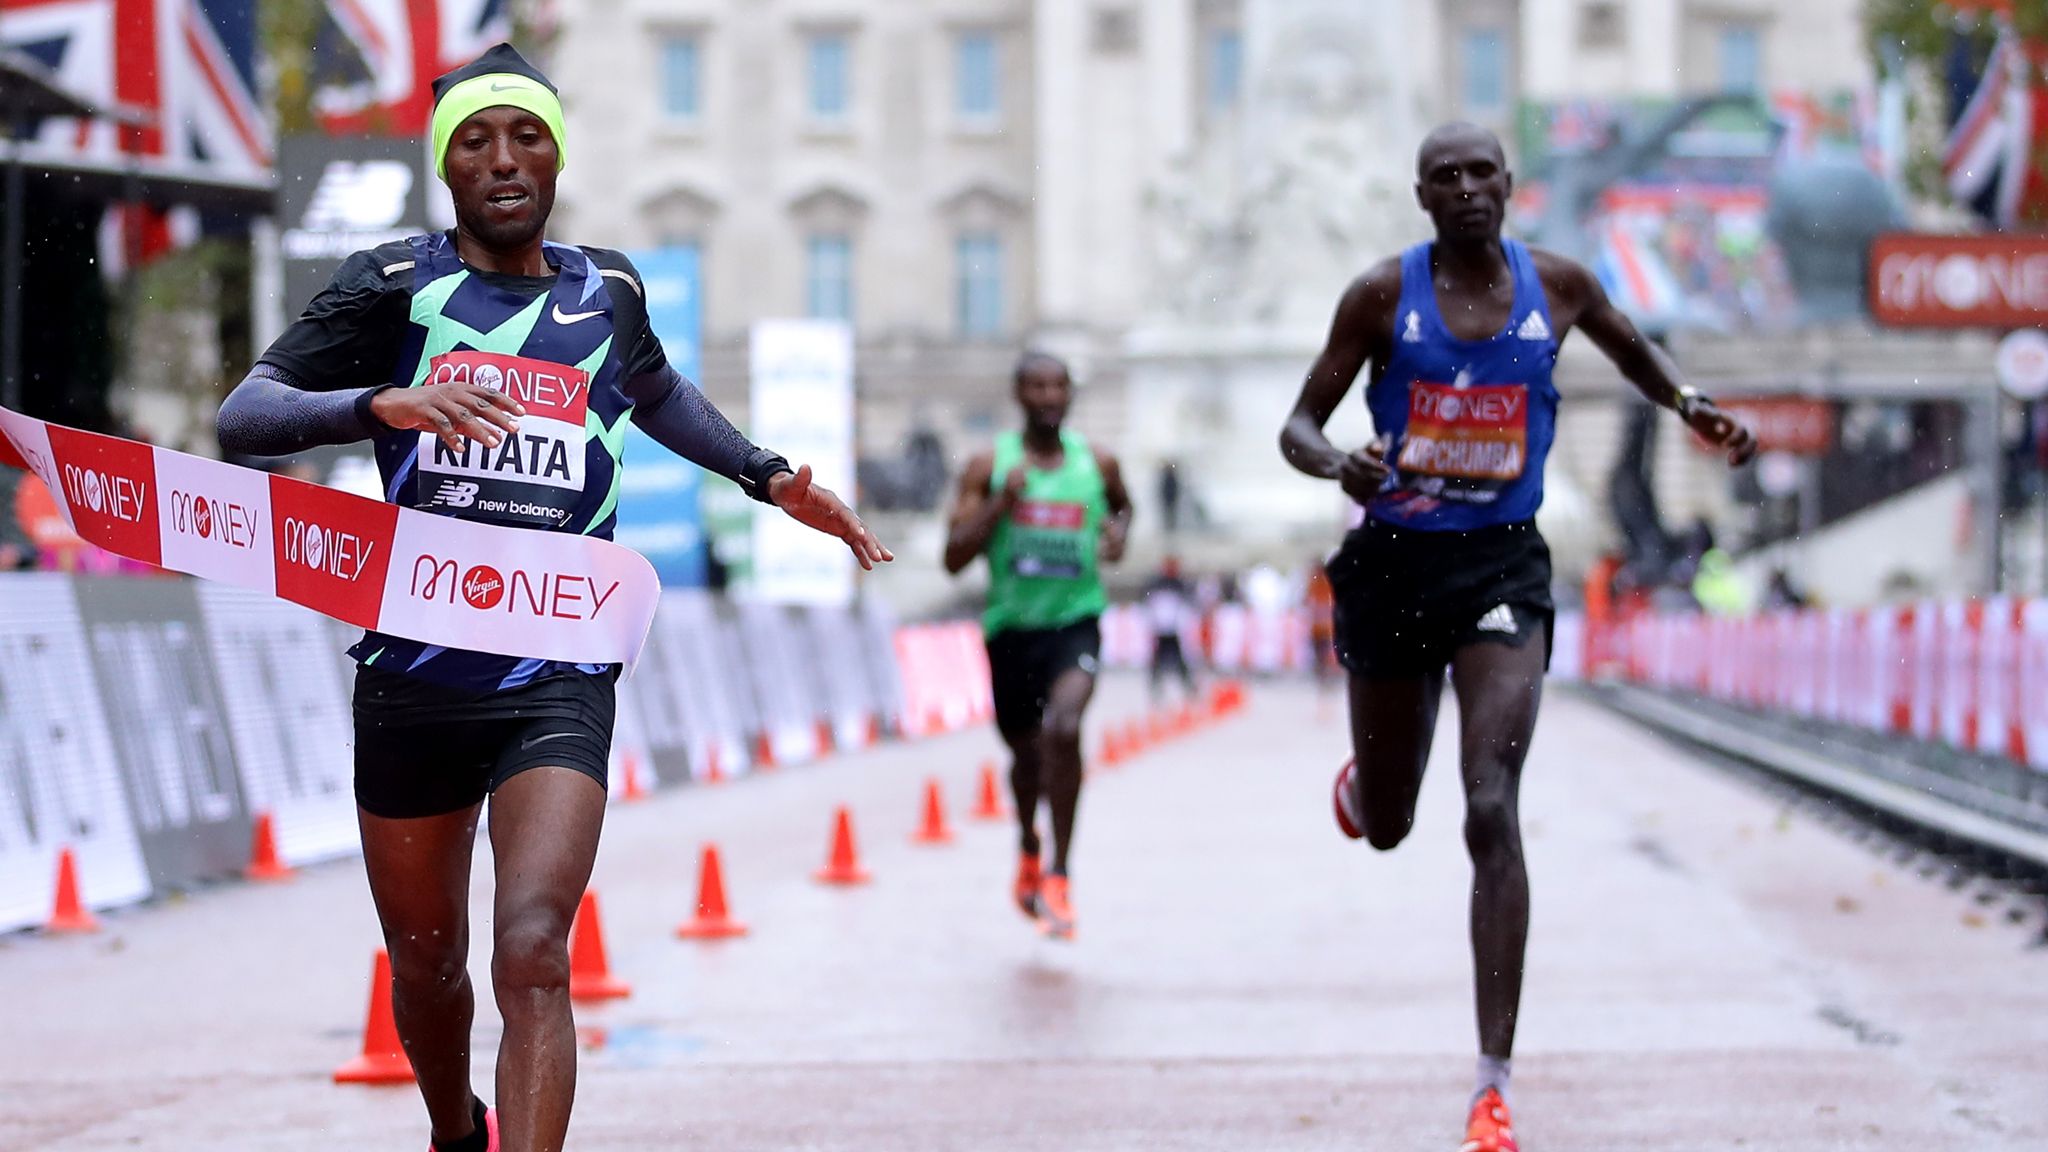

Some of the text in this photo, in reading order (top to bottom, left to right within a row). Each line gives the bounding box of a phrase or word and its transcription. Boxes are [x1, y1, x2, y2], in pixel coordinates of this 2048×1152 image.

[1413, 388, 1521, 421] MONEY
[65, 463, 145, 523] MONEY
[171, 490, 258, 549] MONEY
[478, 499, 565, 520] new balance
[284, 517, 374, 582] MONEY
[410, 554, 620, 620] MONEY
[465, 570, 501, 604] Virgin
